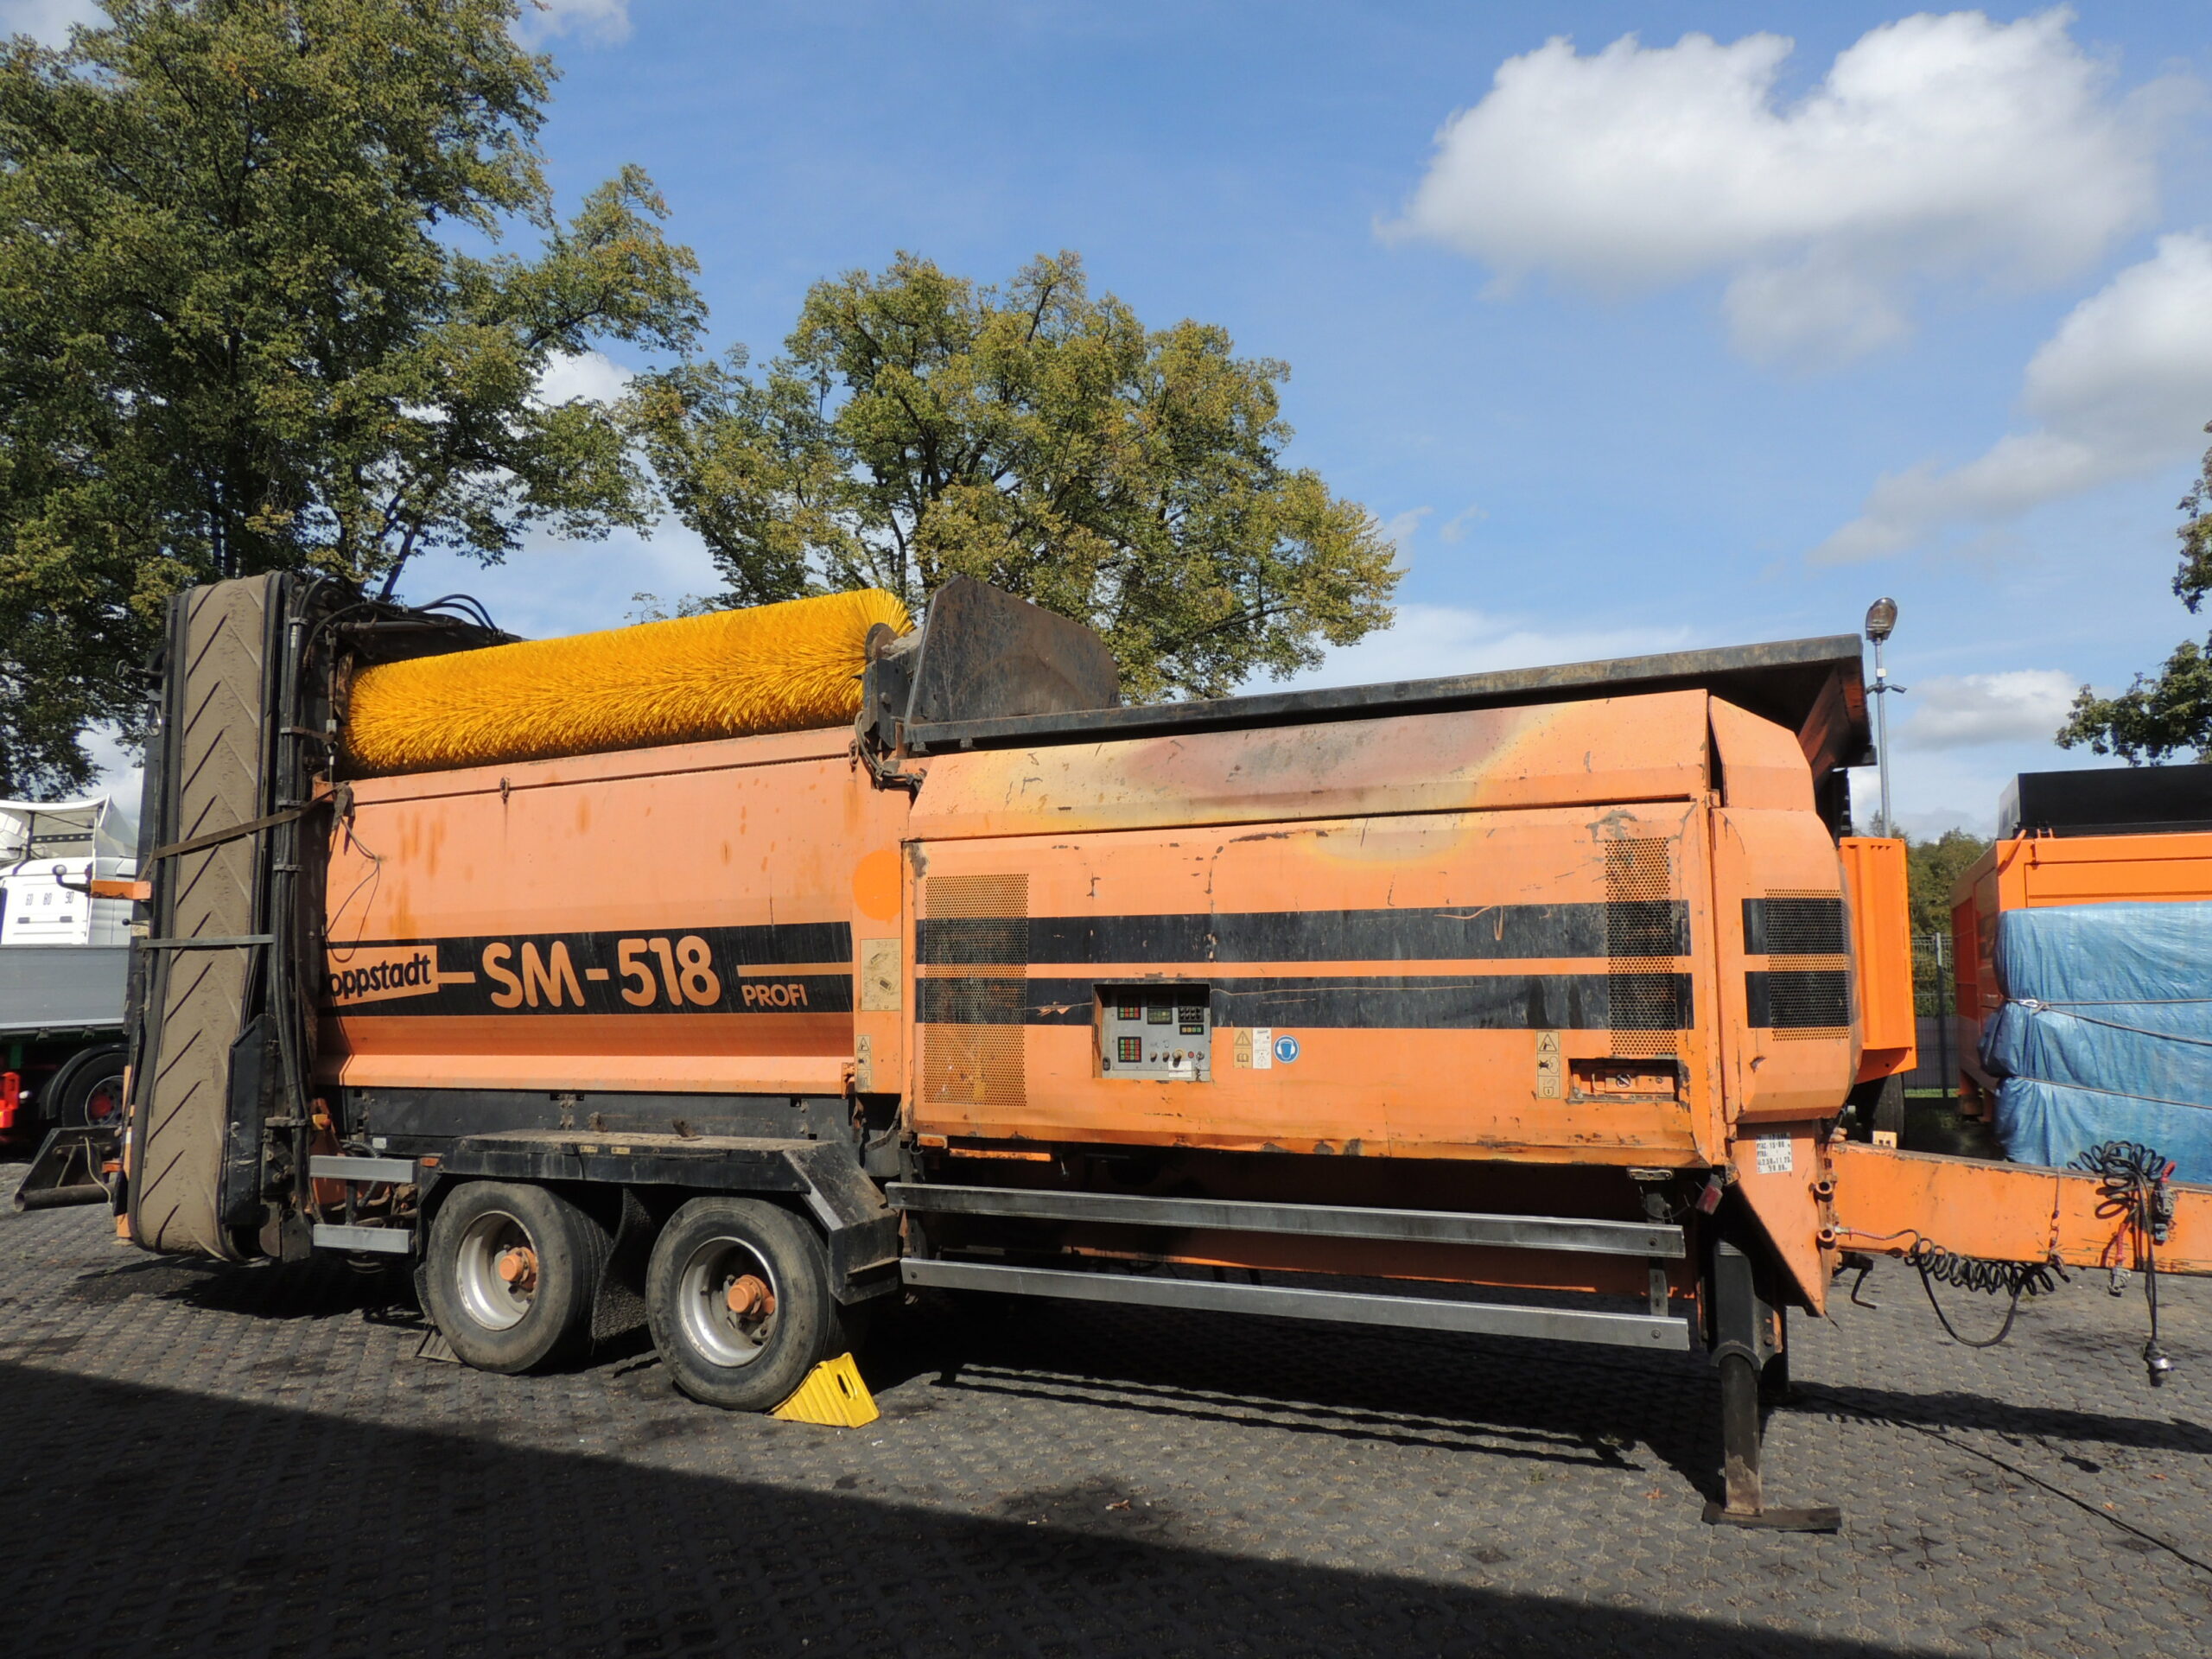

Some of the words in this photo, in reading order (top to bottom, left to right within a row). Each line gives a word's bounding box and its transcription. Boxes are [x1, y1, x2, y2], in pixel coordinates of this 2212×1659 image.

[327, 952, 431, 999] oppstadt
[482, 935, 721, 1008] SM-518
[741, 983, 808, 1006] PROFI
